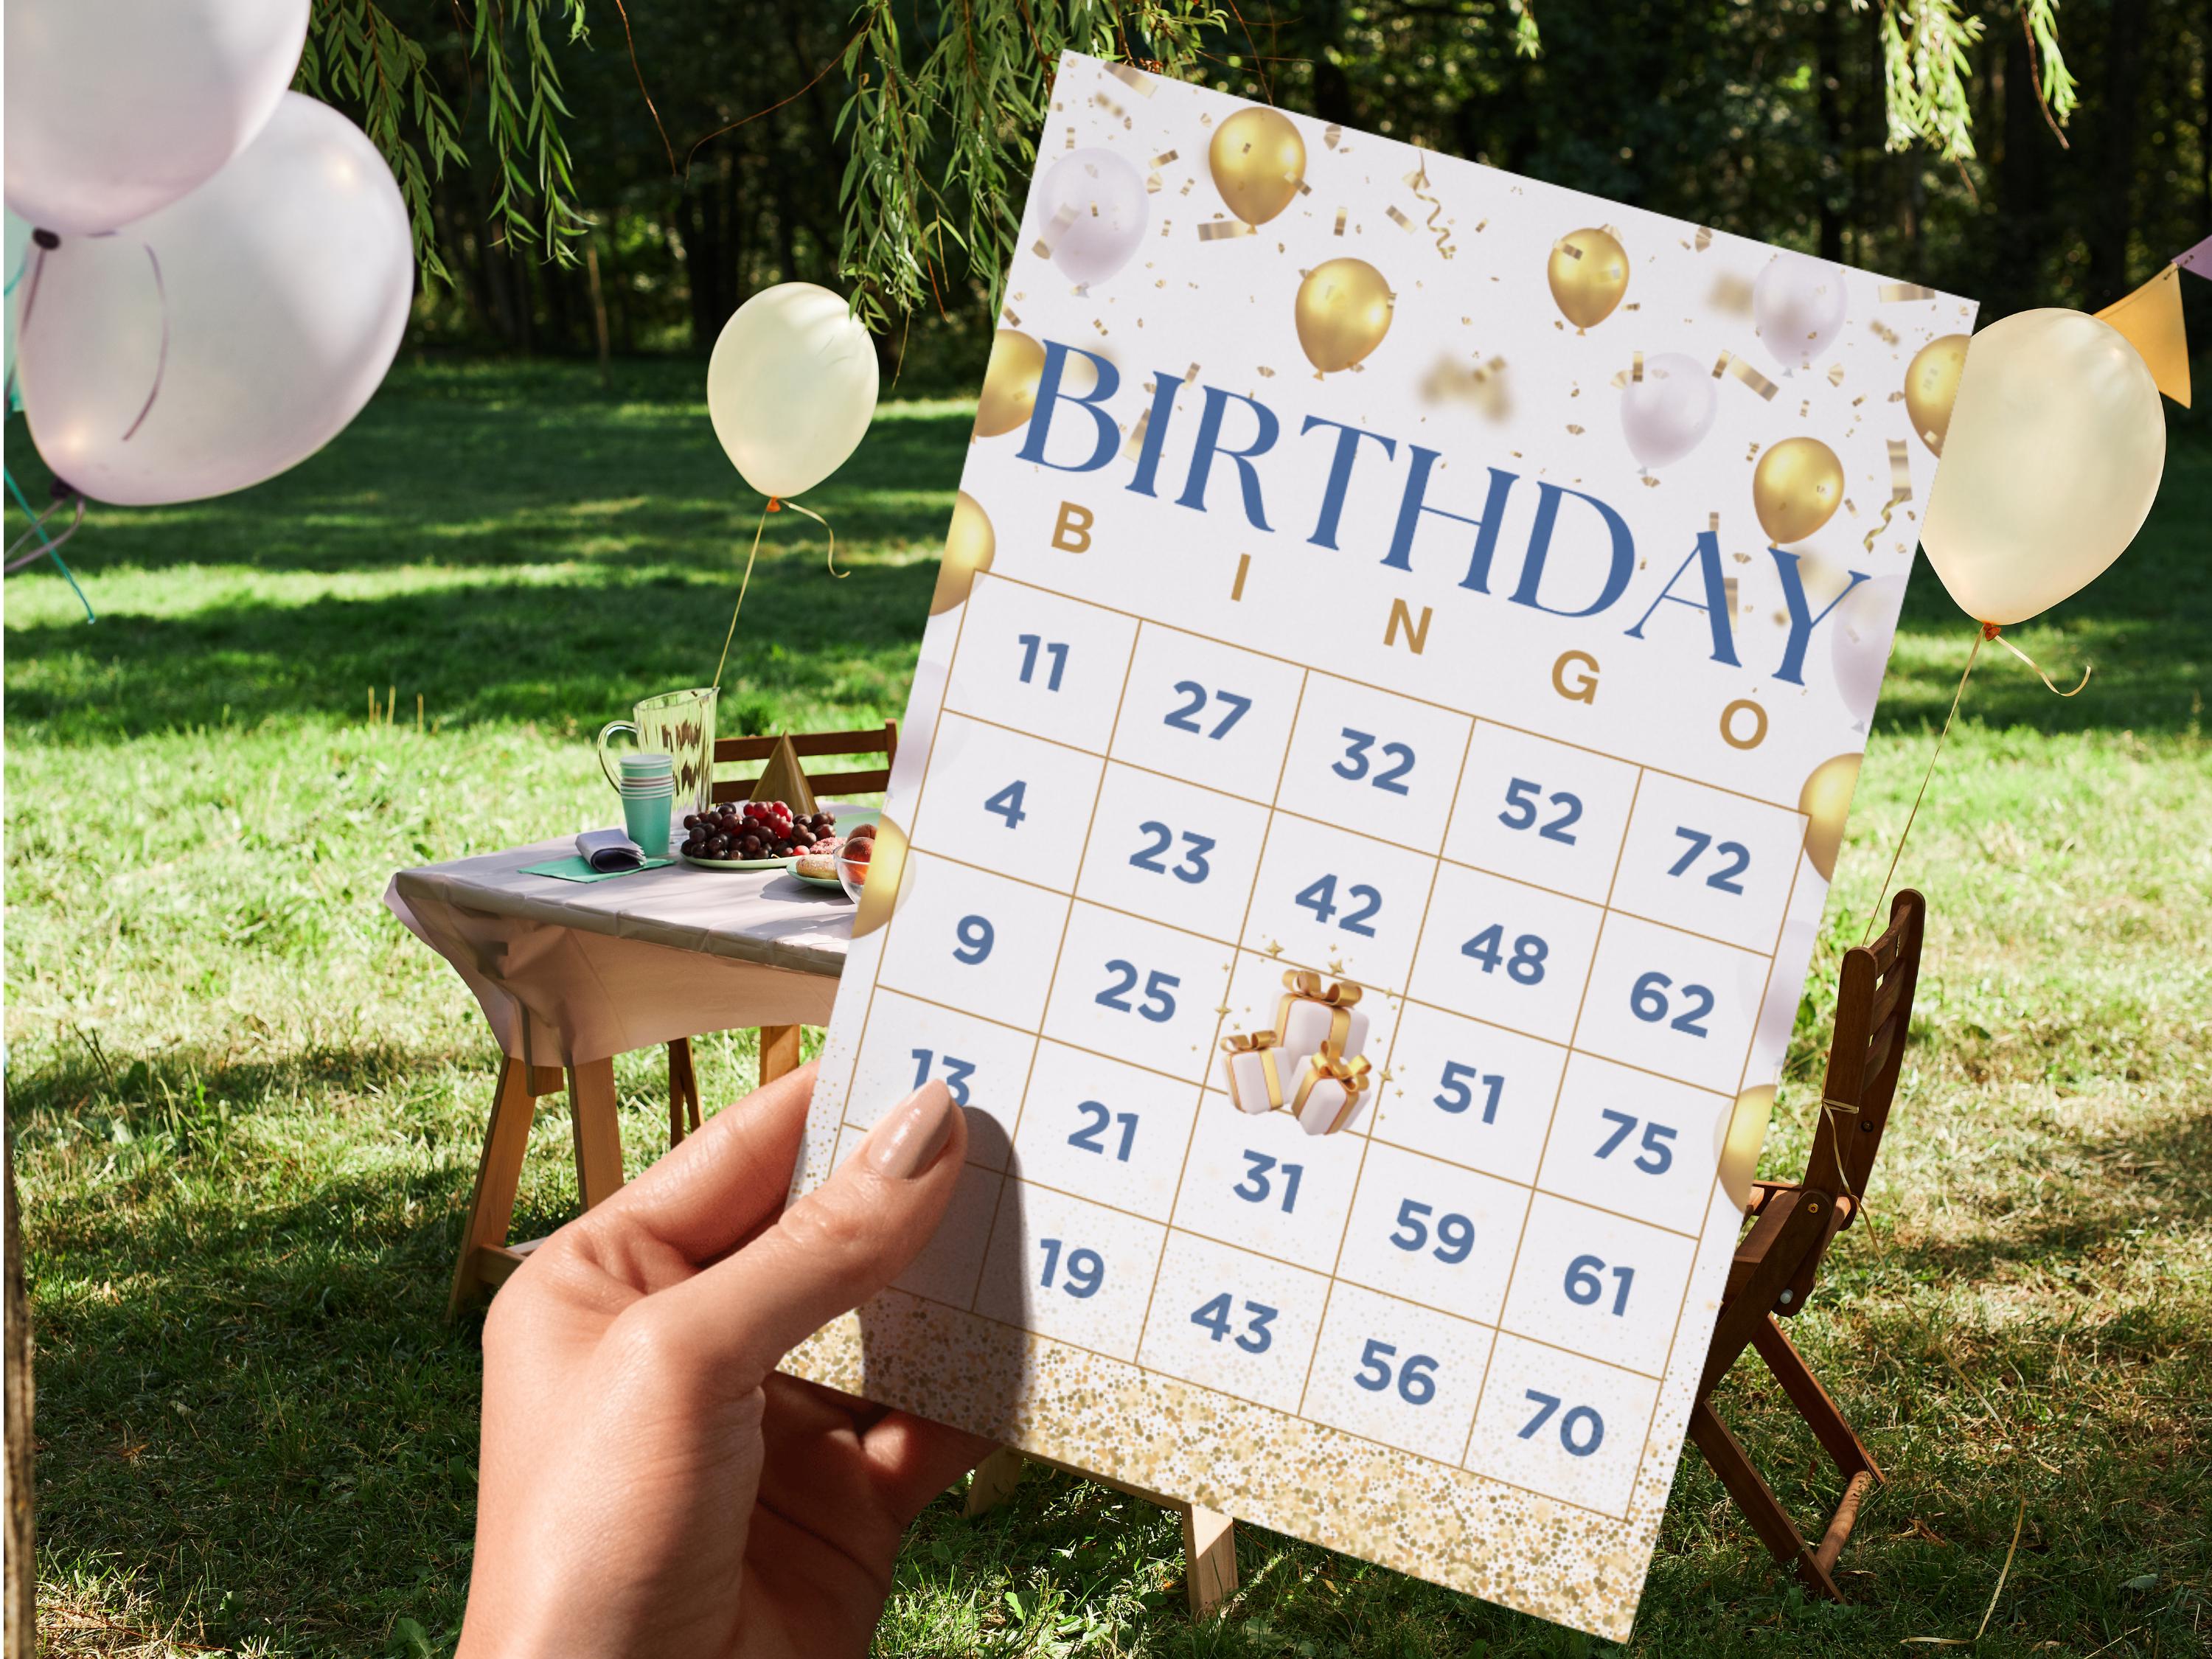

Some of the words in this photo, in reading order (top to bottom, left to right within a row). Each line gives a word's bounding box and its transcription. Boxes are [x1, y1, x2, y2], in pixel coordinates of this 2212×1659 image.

[1015, 338, 1871, 686] BIRTHDAY
[1018, 633, 1069, 692] 11
[1164, 681, 1252, 740] 27
[1332, 727, 1416, 796] 32
[1498, 777, 1583, 846] 52
[1668, 826, 1750, 895] 72
[984, 780, 1027, 830] 4
[1129, 821, 1216, 884] 23
[1295, 874, 1382, 938] 42
[1461, 924, 1549, 986] 48
[1630, 971, 1715, 1038] 62
[953, 915, 995, 965] 9
[1095, 959, 1180, 1023] 25
[1433, 1060, 1504, 1124] 51
[1595, 1108, 1677, 1175] 75
[911, 1048, 975, 1107] 13
[1068, 1100, 1138, 1162] 21
[1234, 1150, 1304, 1213] 31
[1390, 1198, 1475, 1265] 59
[1564, 1254, 1634, 1316] 61
[1040, 1238, 1105, 1299] 19
[1190, 1293, 1279, 1354] 43
[1354, 1338, 1439, 1405] 56
[1518, 1389, 1604, 1457] 70
